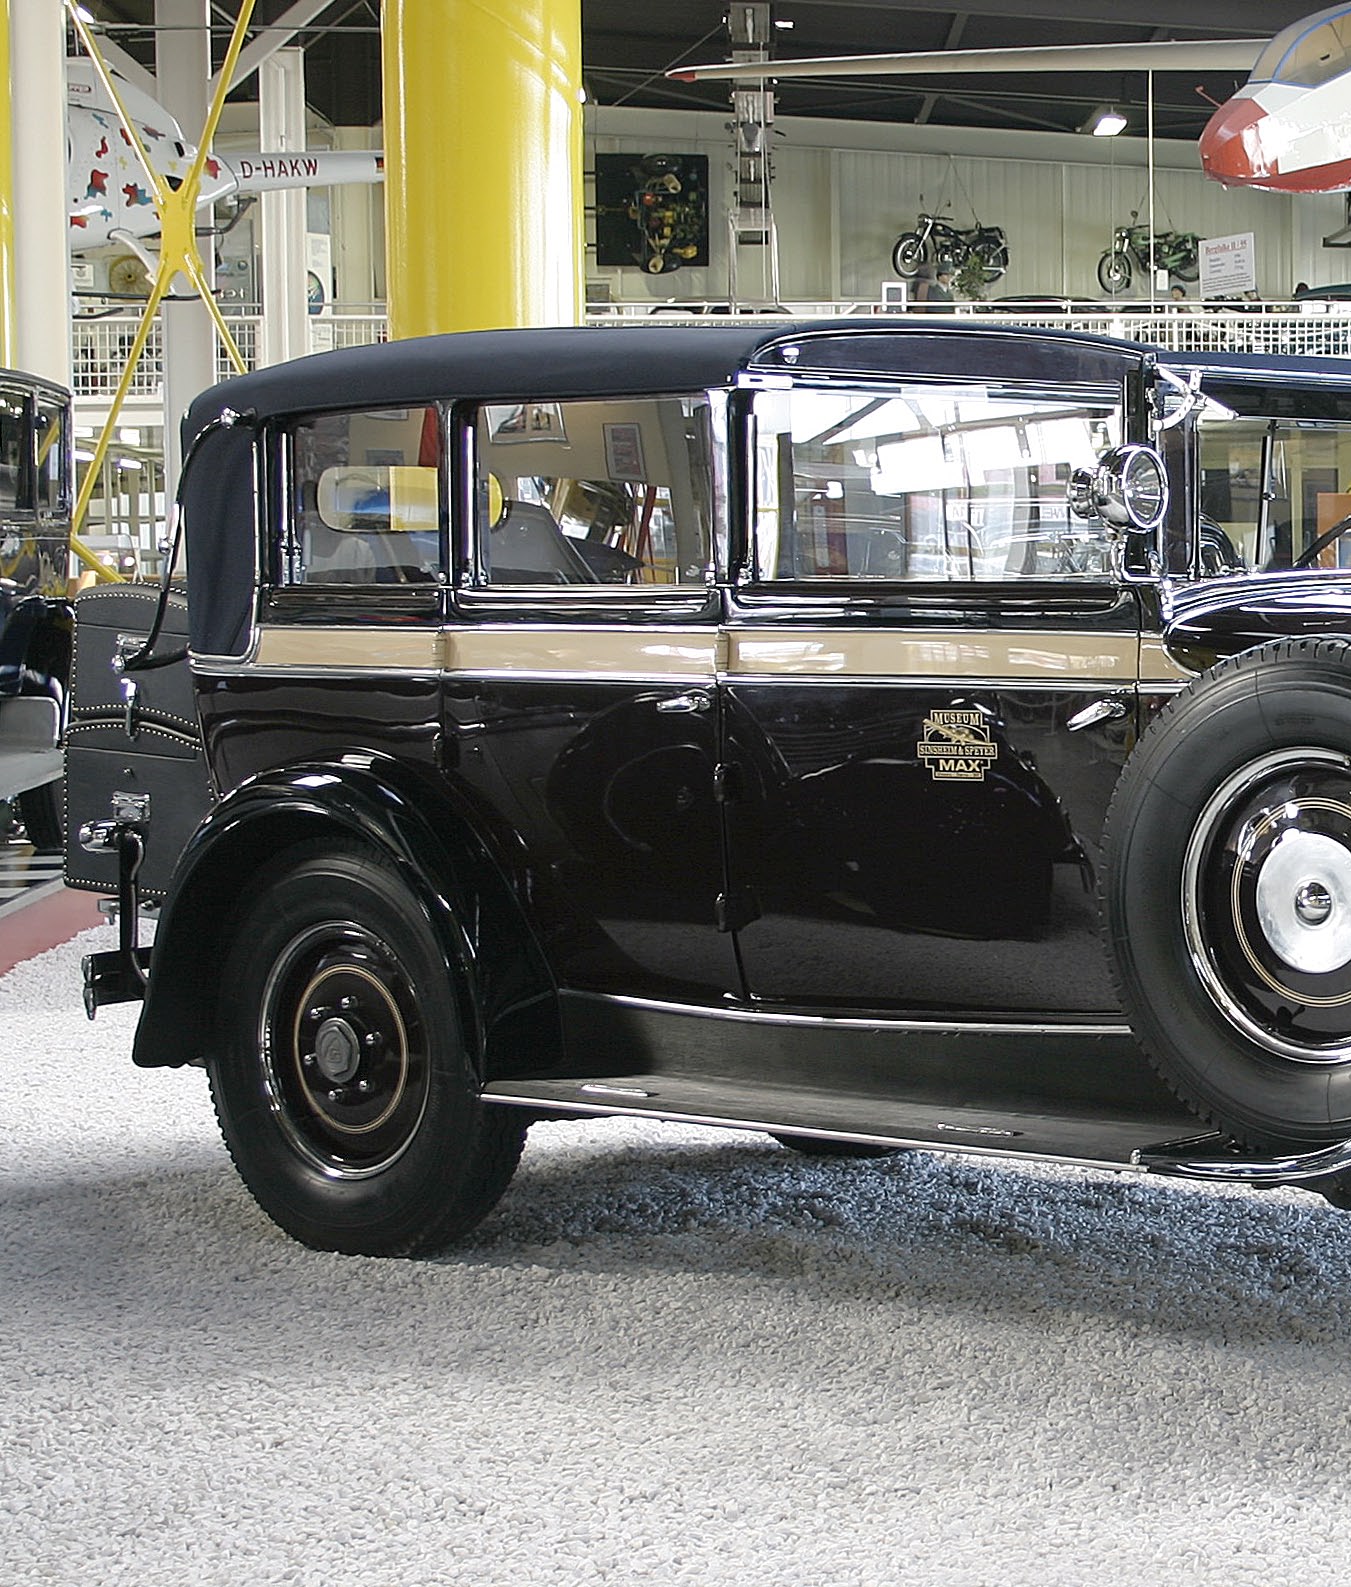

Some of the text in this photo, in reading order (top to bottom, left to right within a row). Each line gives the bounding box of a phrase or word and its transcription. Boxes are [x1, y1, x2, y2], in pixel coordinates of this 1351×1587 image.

[241, 158, 319, 179] D-HAKW
[934, 712, 980, 726] MUSEUM
[919, 745, 957, 755] SINSHEIM
[965, 746, 995, 756] SPEYER
[939, 759, 980, 772] MAX
